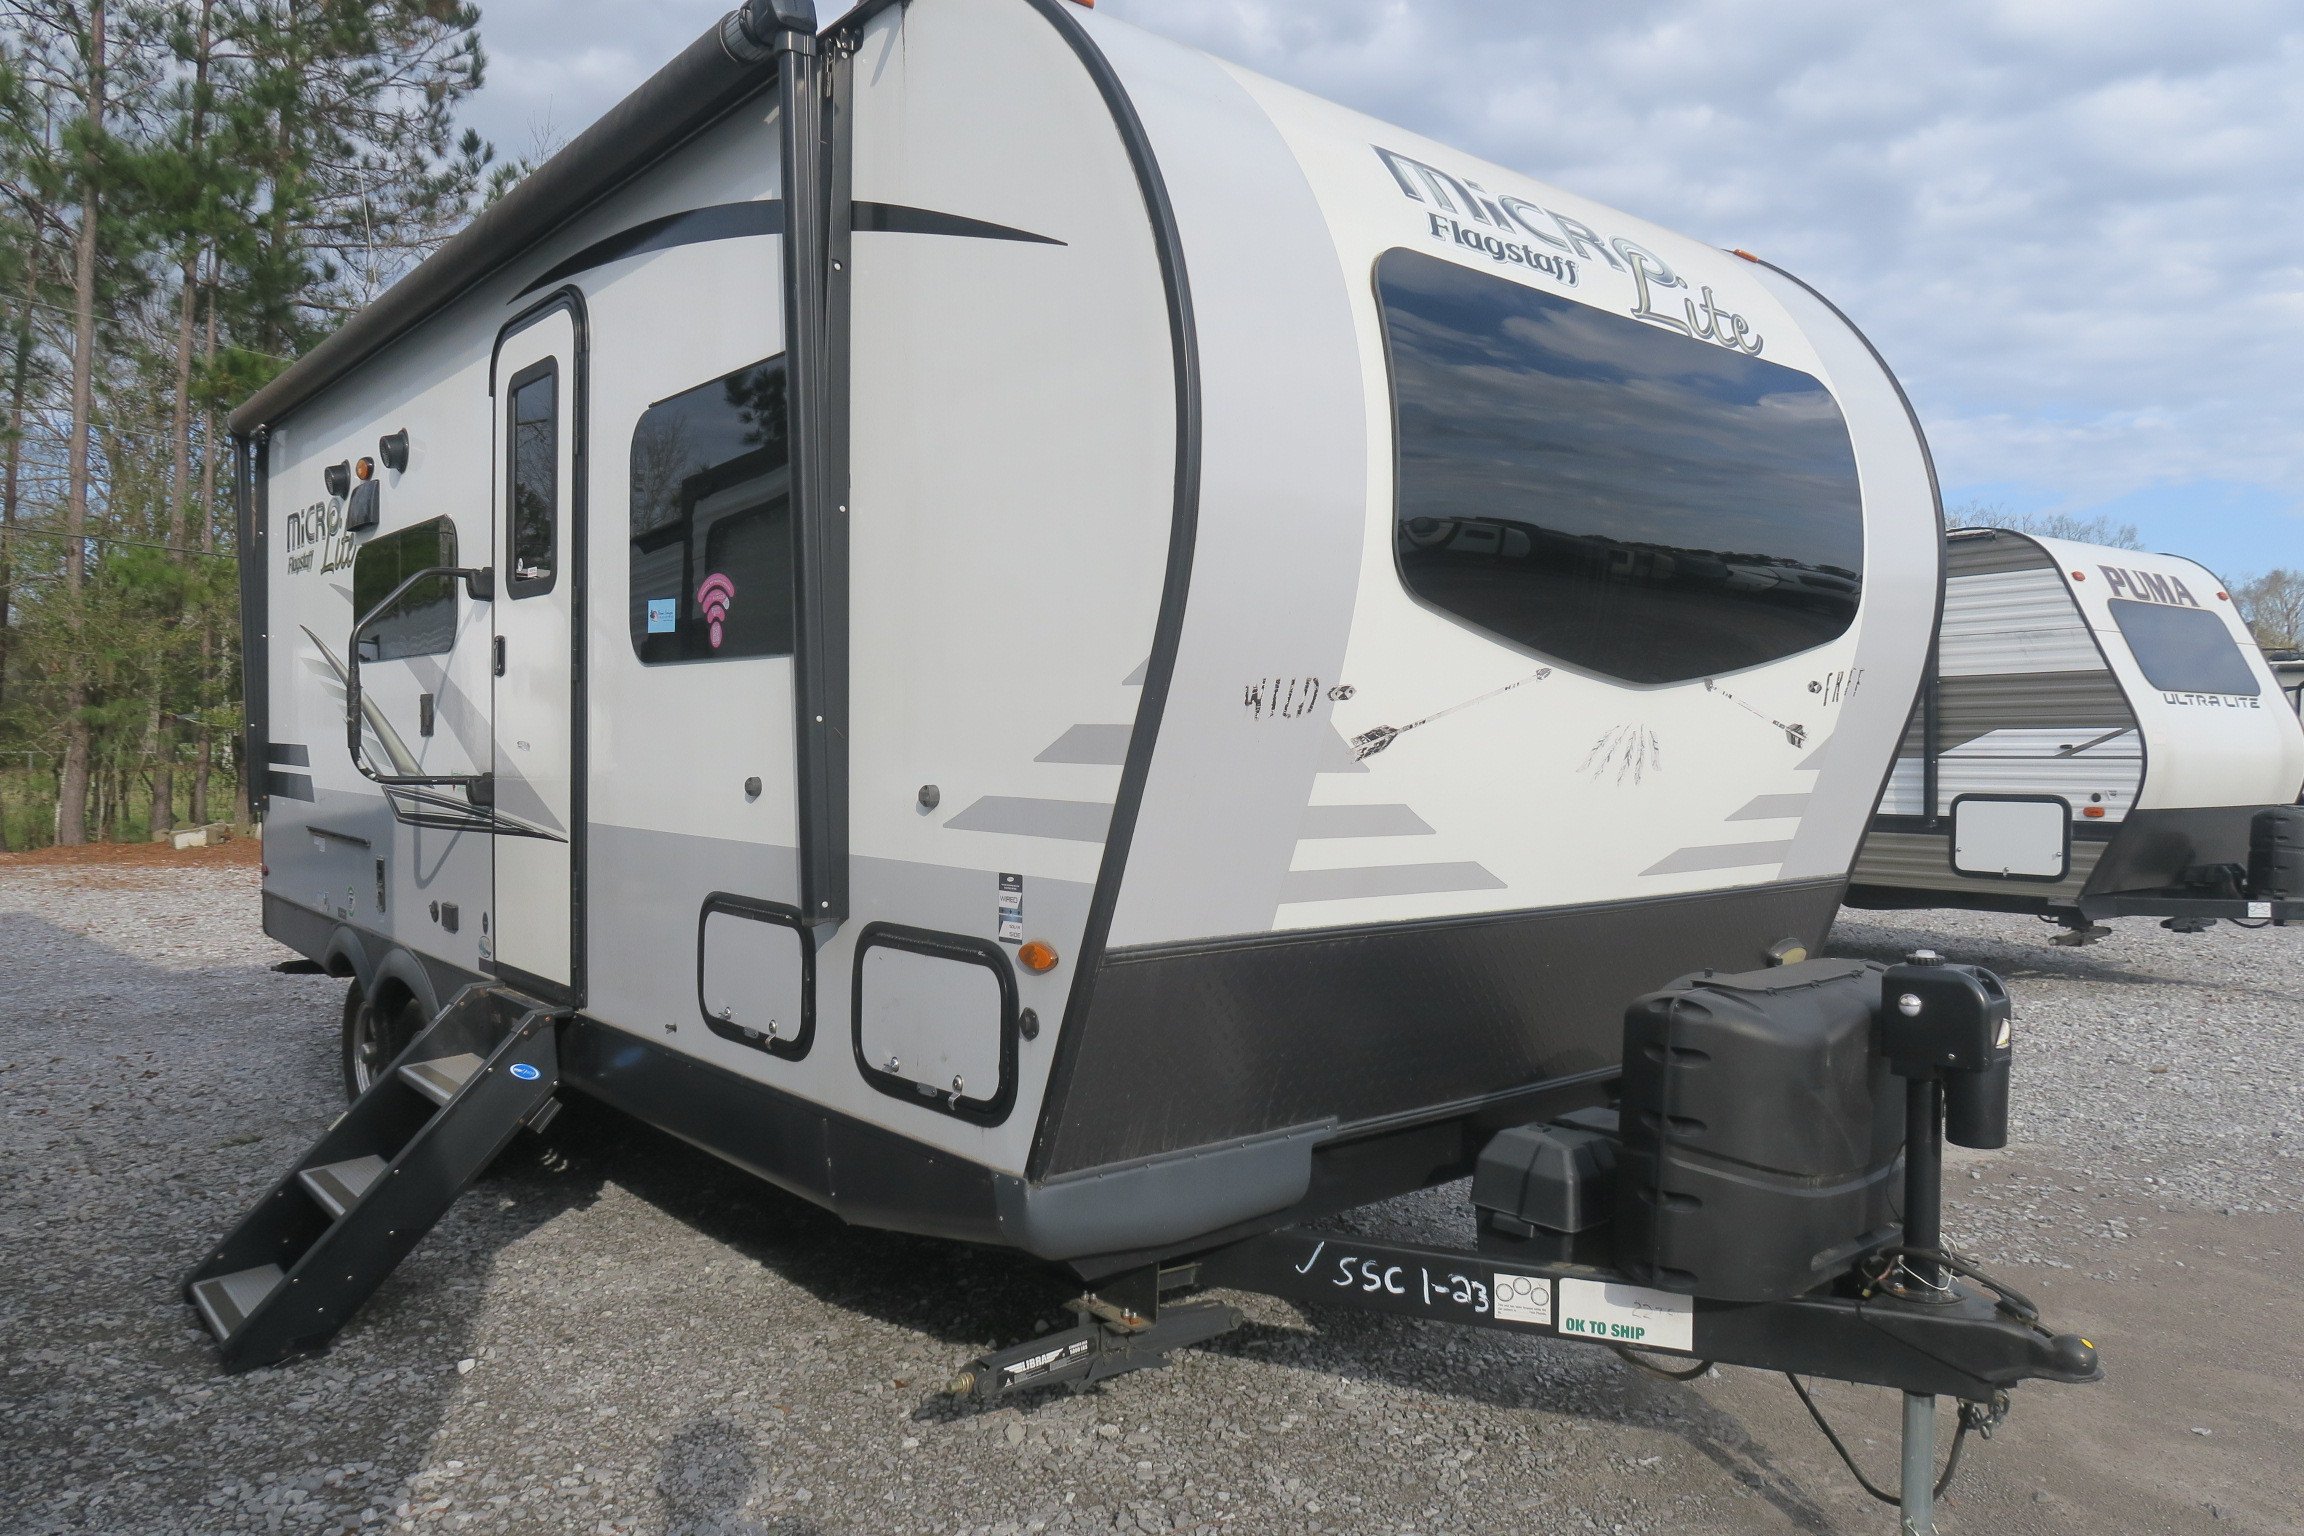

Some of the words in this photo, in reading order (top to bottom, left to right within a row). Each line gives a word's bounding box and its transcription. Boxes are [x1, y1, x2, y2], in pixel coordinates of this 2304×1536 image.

[1427, 211, 1579, 286] Flagstaff
[1630, 252, 1764, 356] Lite
[2097, 564, 2200, 607] PUMA
[1244, 677, 1319, 721] WILD
[2163, 693, 2221, 706] ULTRA
[2224, 696, 2261, 709] LITE
[1333, 1257, 1405, 1294] SSC
[1421, 1267, 1489, 1313] 1-23
[1565, 1317, 1585, 1332] OK
[1589, 1320, 1607, 1335] TO
[1610, 1323, 1645, 1340] SHIP
[1022, 1353, 1047, 1371] LIBRA
